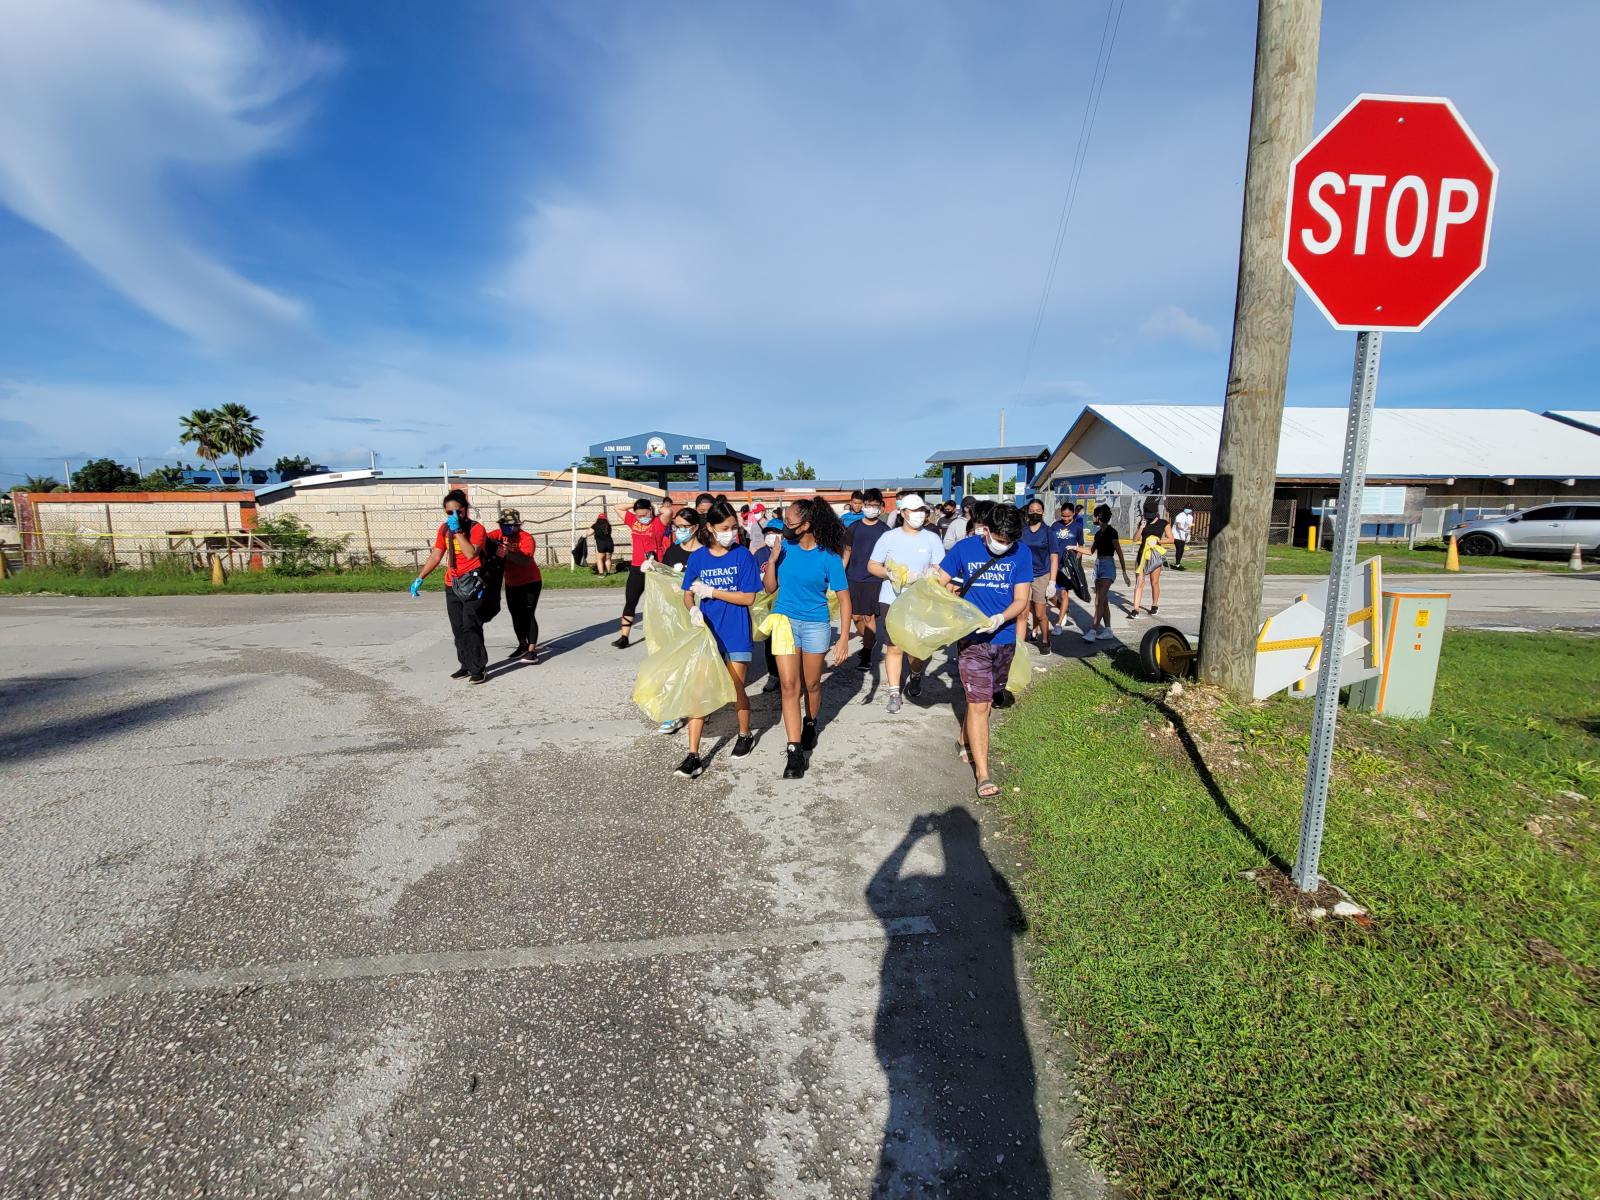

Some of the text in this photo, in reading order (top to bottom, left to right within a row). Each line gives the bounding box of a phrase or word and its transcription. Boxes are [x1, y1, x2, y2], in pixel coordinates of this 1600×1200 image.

[1301, 171, 1479, 258] STOP
[968, 561, 1011, 571] INTACT
[700, 566, 738, 577] INTERACT
[977, 572, 1005, 581] AIPAN
[705, 576, 734, 586] SAIPAN
